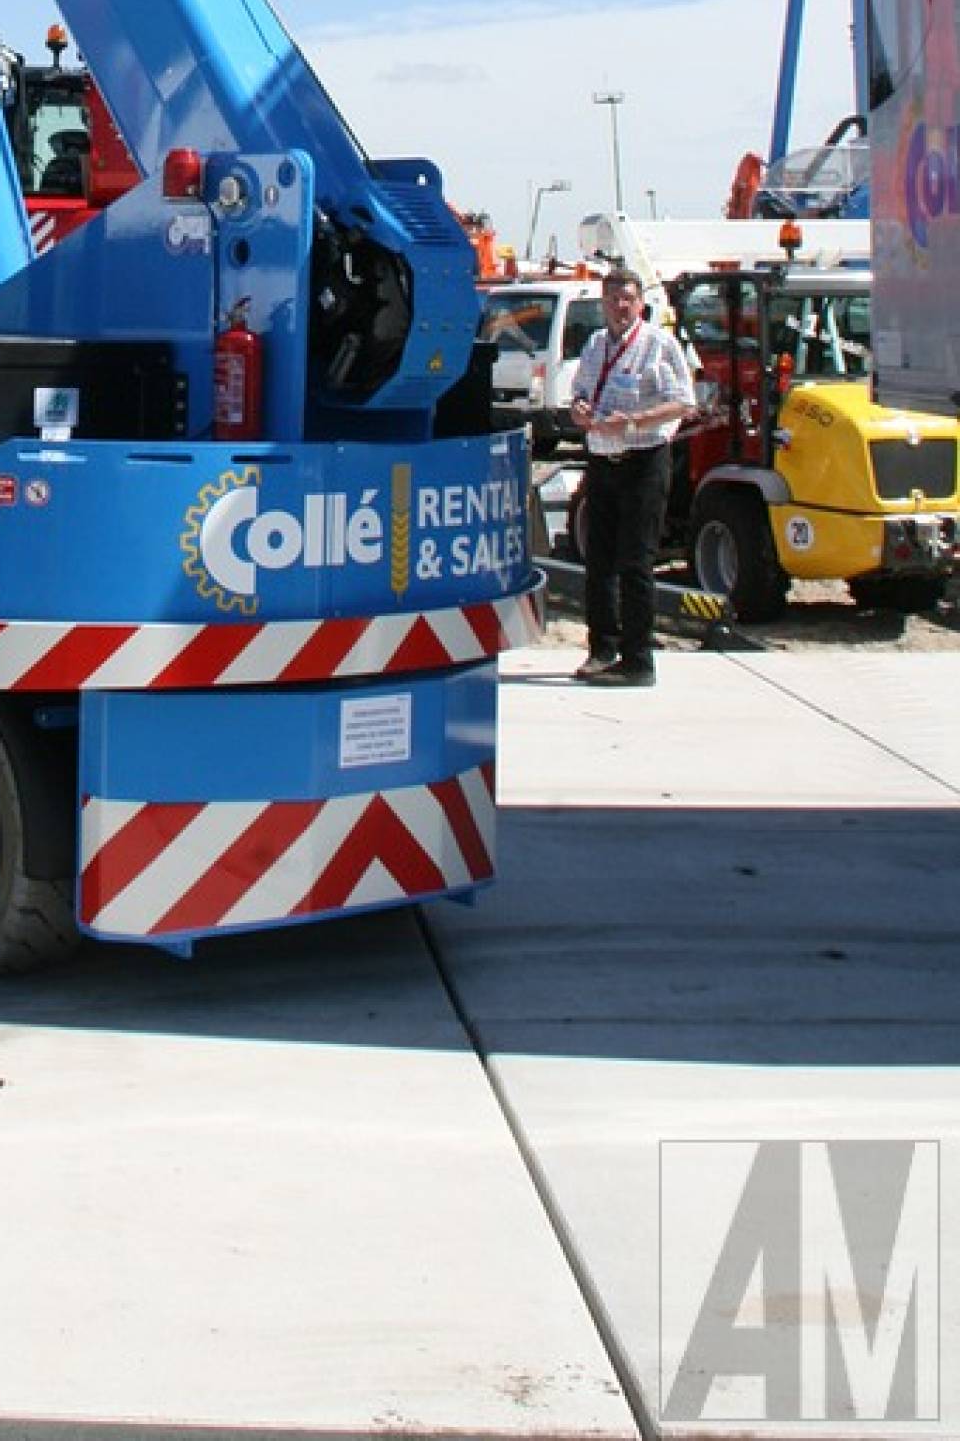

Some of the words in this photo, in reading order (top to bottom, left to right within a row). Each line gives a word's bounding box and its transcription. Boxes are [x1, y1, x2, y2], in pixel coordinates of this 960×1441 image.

[417, 479, 523, 529] RENTAL
[199, 484, 386, 596] Collé
[416, 538, 442, 579] &
[451, 526, 525, 576] SALES
